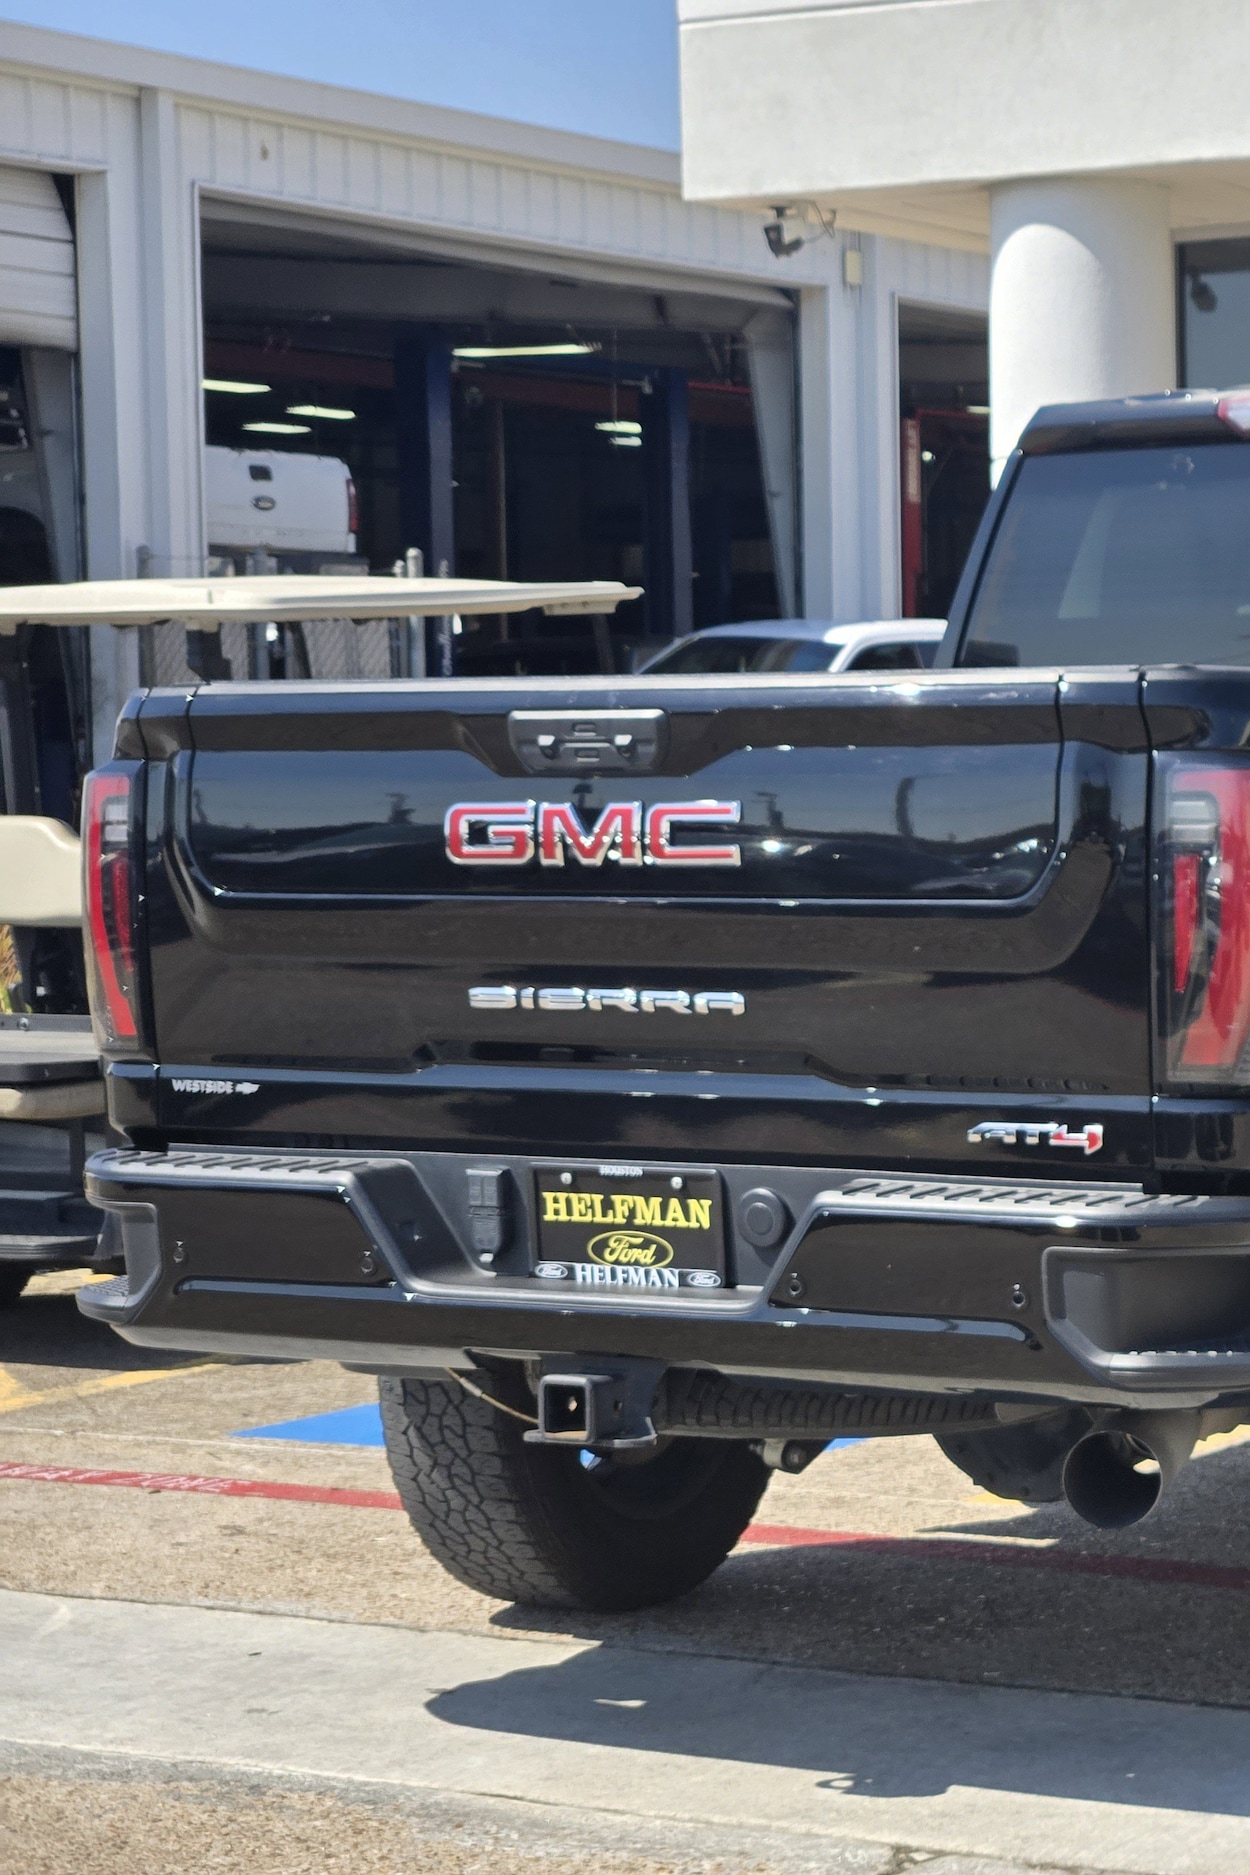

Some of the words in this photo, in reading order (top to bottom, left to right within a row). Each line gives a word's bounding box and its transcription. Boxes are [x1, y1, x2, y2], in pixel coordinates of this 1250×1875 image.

[445, 799, 741, 867] GMC
[468, 985, 746, 1015] SIERRA
[171, 1078, 234, 1094] WESTSIDE
[967, 1121, 1104, 1156] AT4
[599, 1166, 644, 1177] HOUSTON
[541, 1191, 713, 1230] HELFMAN
[603, 1234, 657, 1265] Ford
[574, 1263, 680, 1289] HELFMAN
